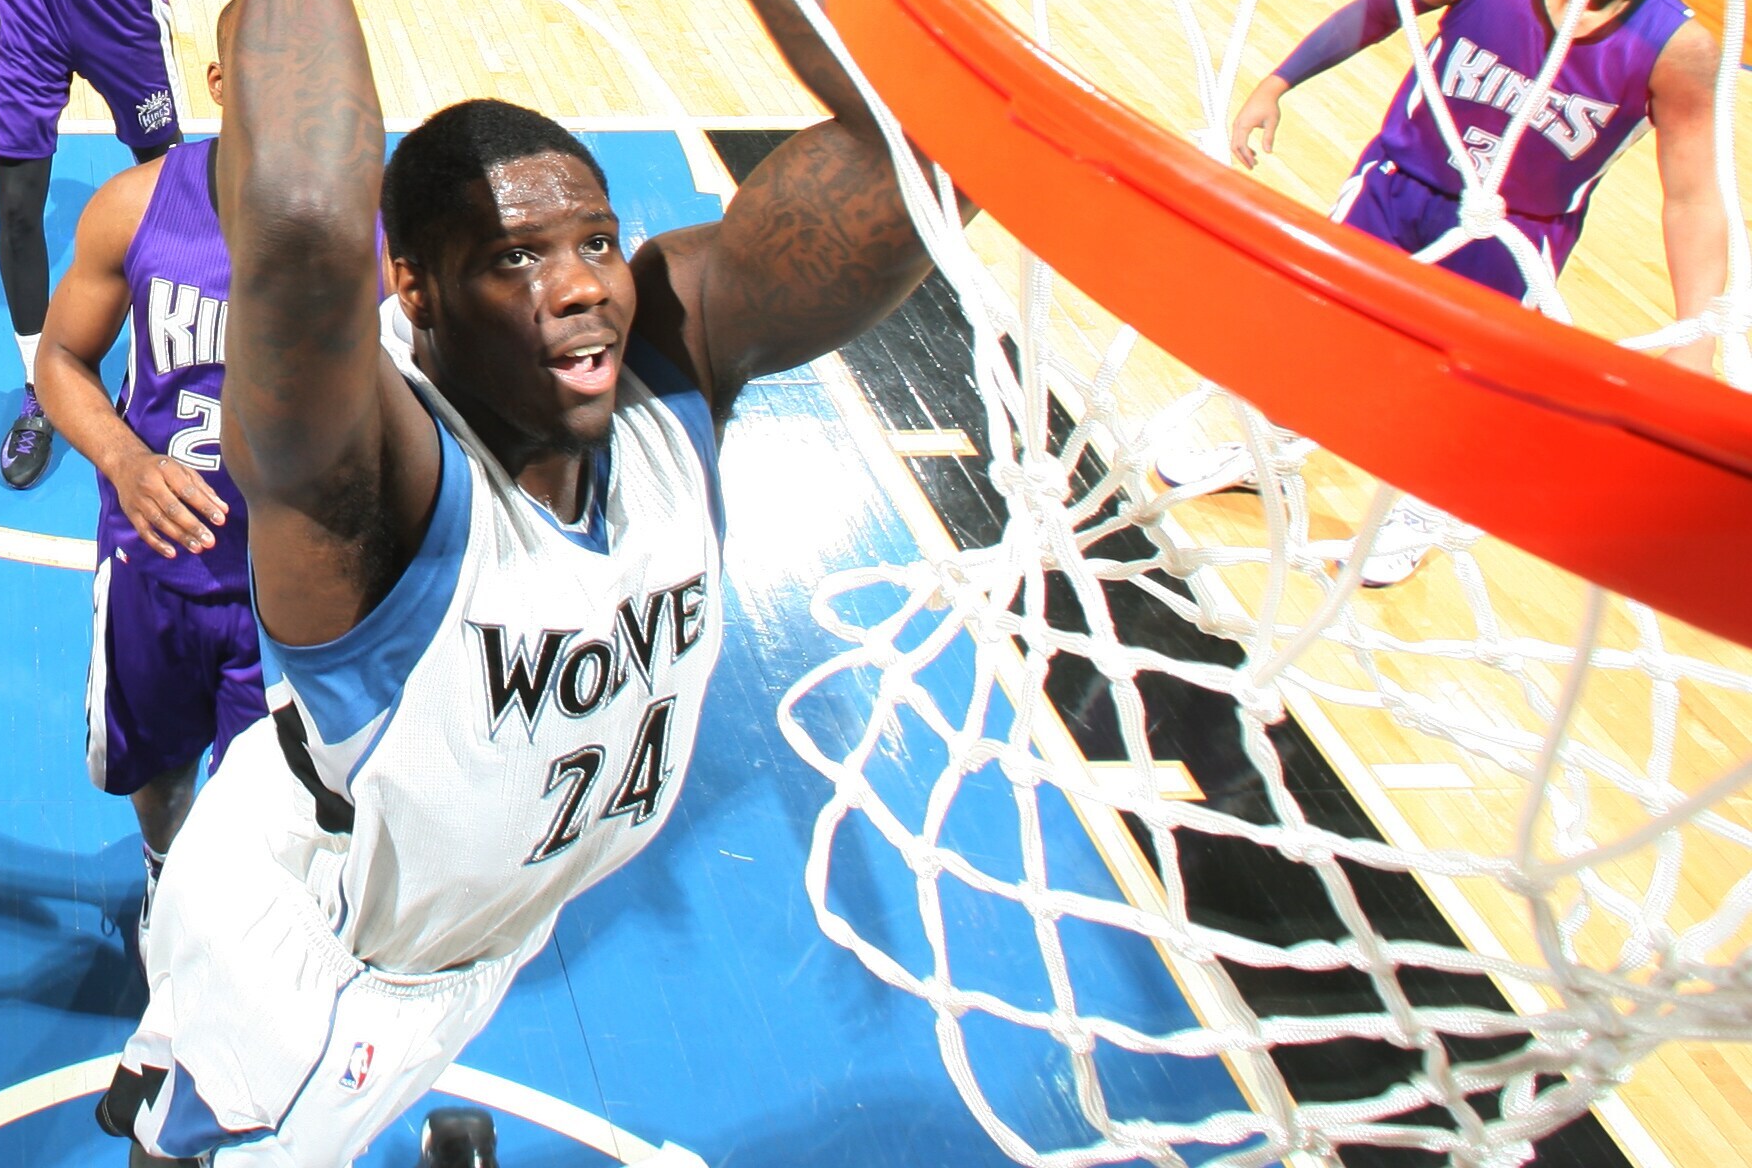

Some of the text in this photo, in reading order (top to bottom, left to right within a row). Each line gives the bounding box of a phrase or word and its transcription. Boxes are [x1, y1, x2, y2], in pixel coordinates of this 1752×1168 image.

[142, 102, 170, 127] KINGS
[1442, 37, 1619, 160] KINGS
[522, 694, 677, 865] 24
